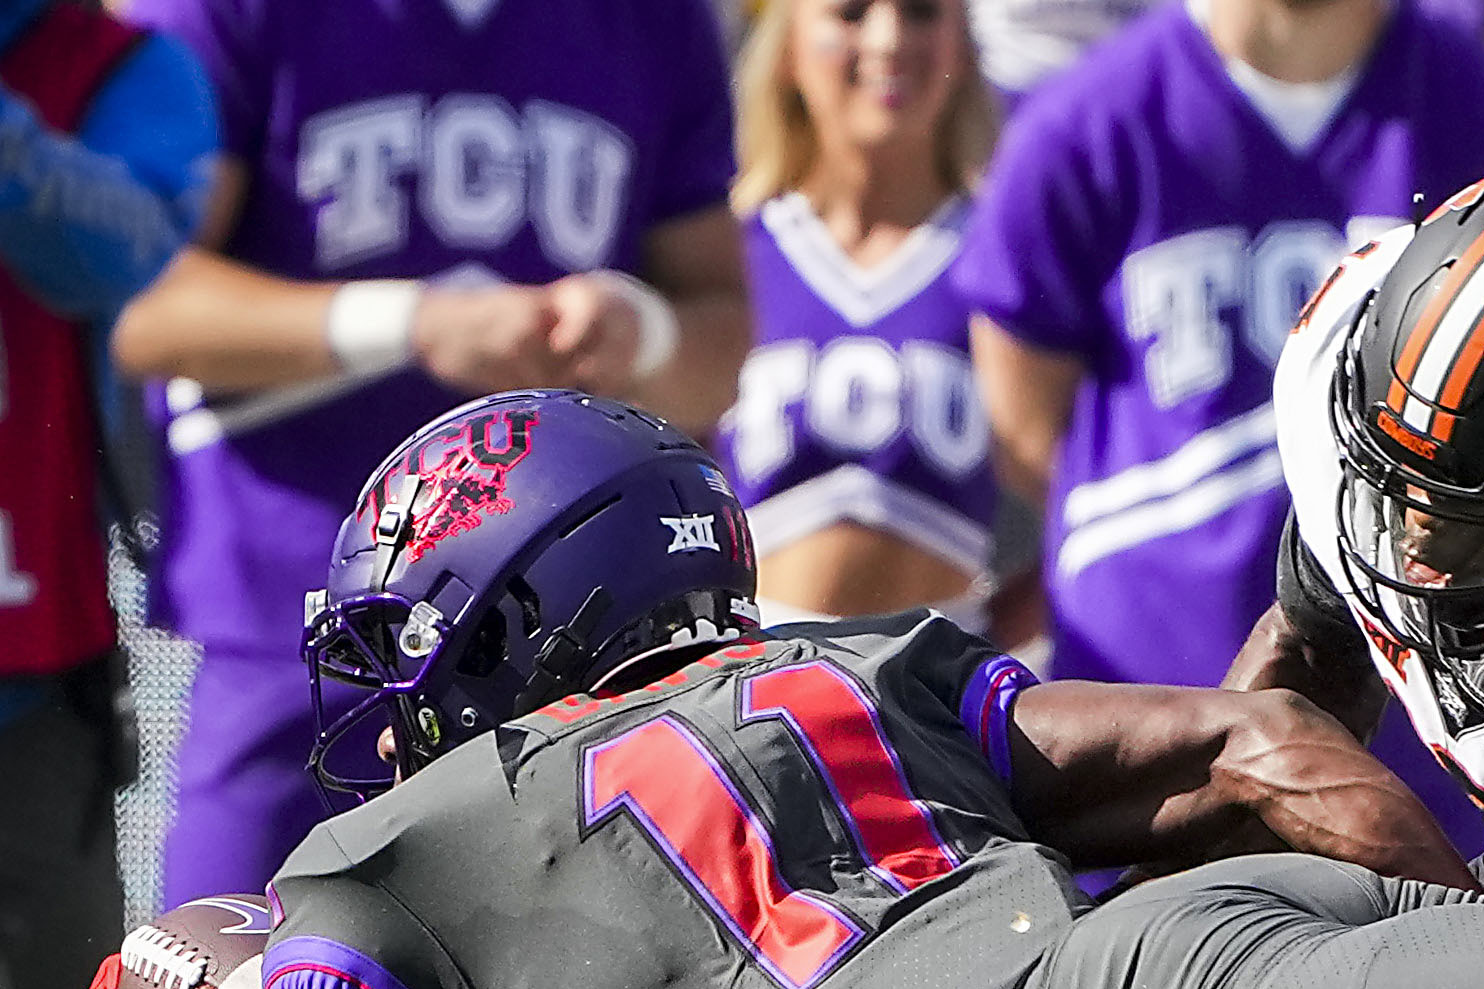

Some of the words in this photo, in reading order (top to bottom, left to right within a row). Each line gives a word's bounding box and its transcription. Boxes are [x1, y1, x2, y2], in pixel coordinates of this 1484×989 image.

[298, 95, 635, 270] TCU
[1121, 216, 1415, 408] TC
[718, 335, 992, 485] TCU
[659, 513, 721, 554] XII
